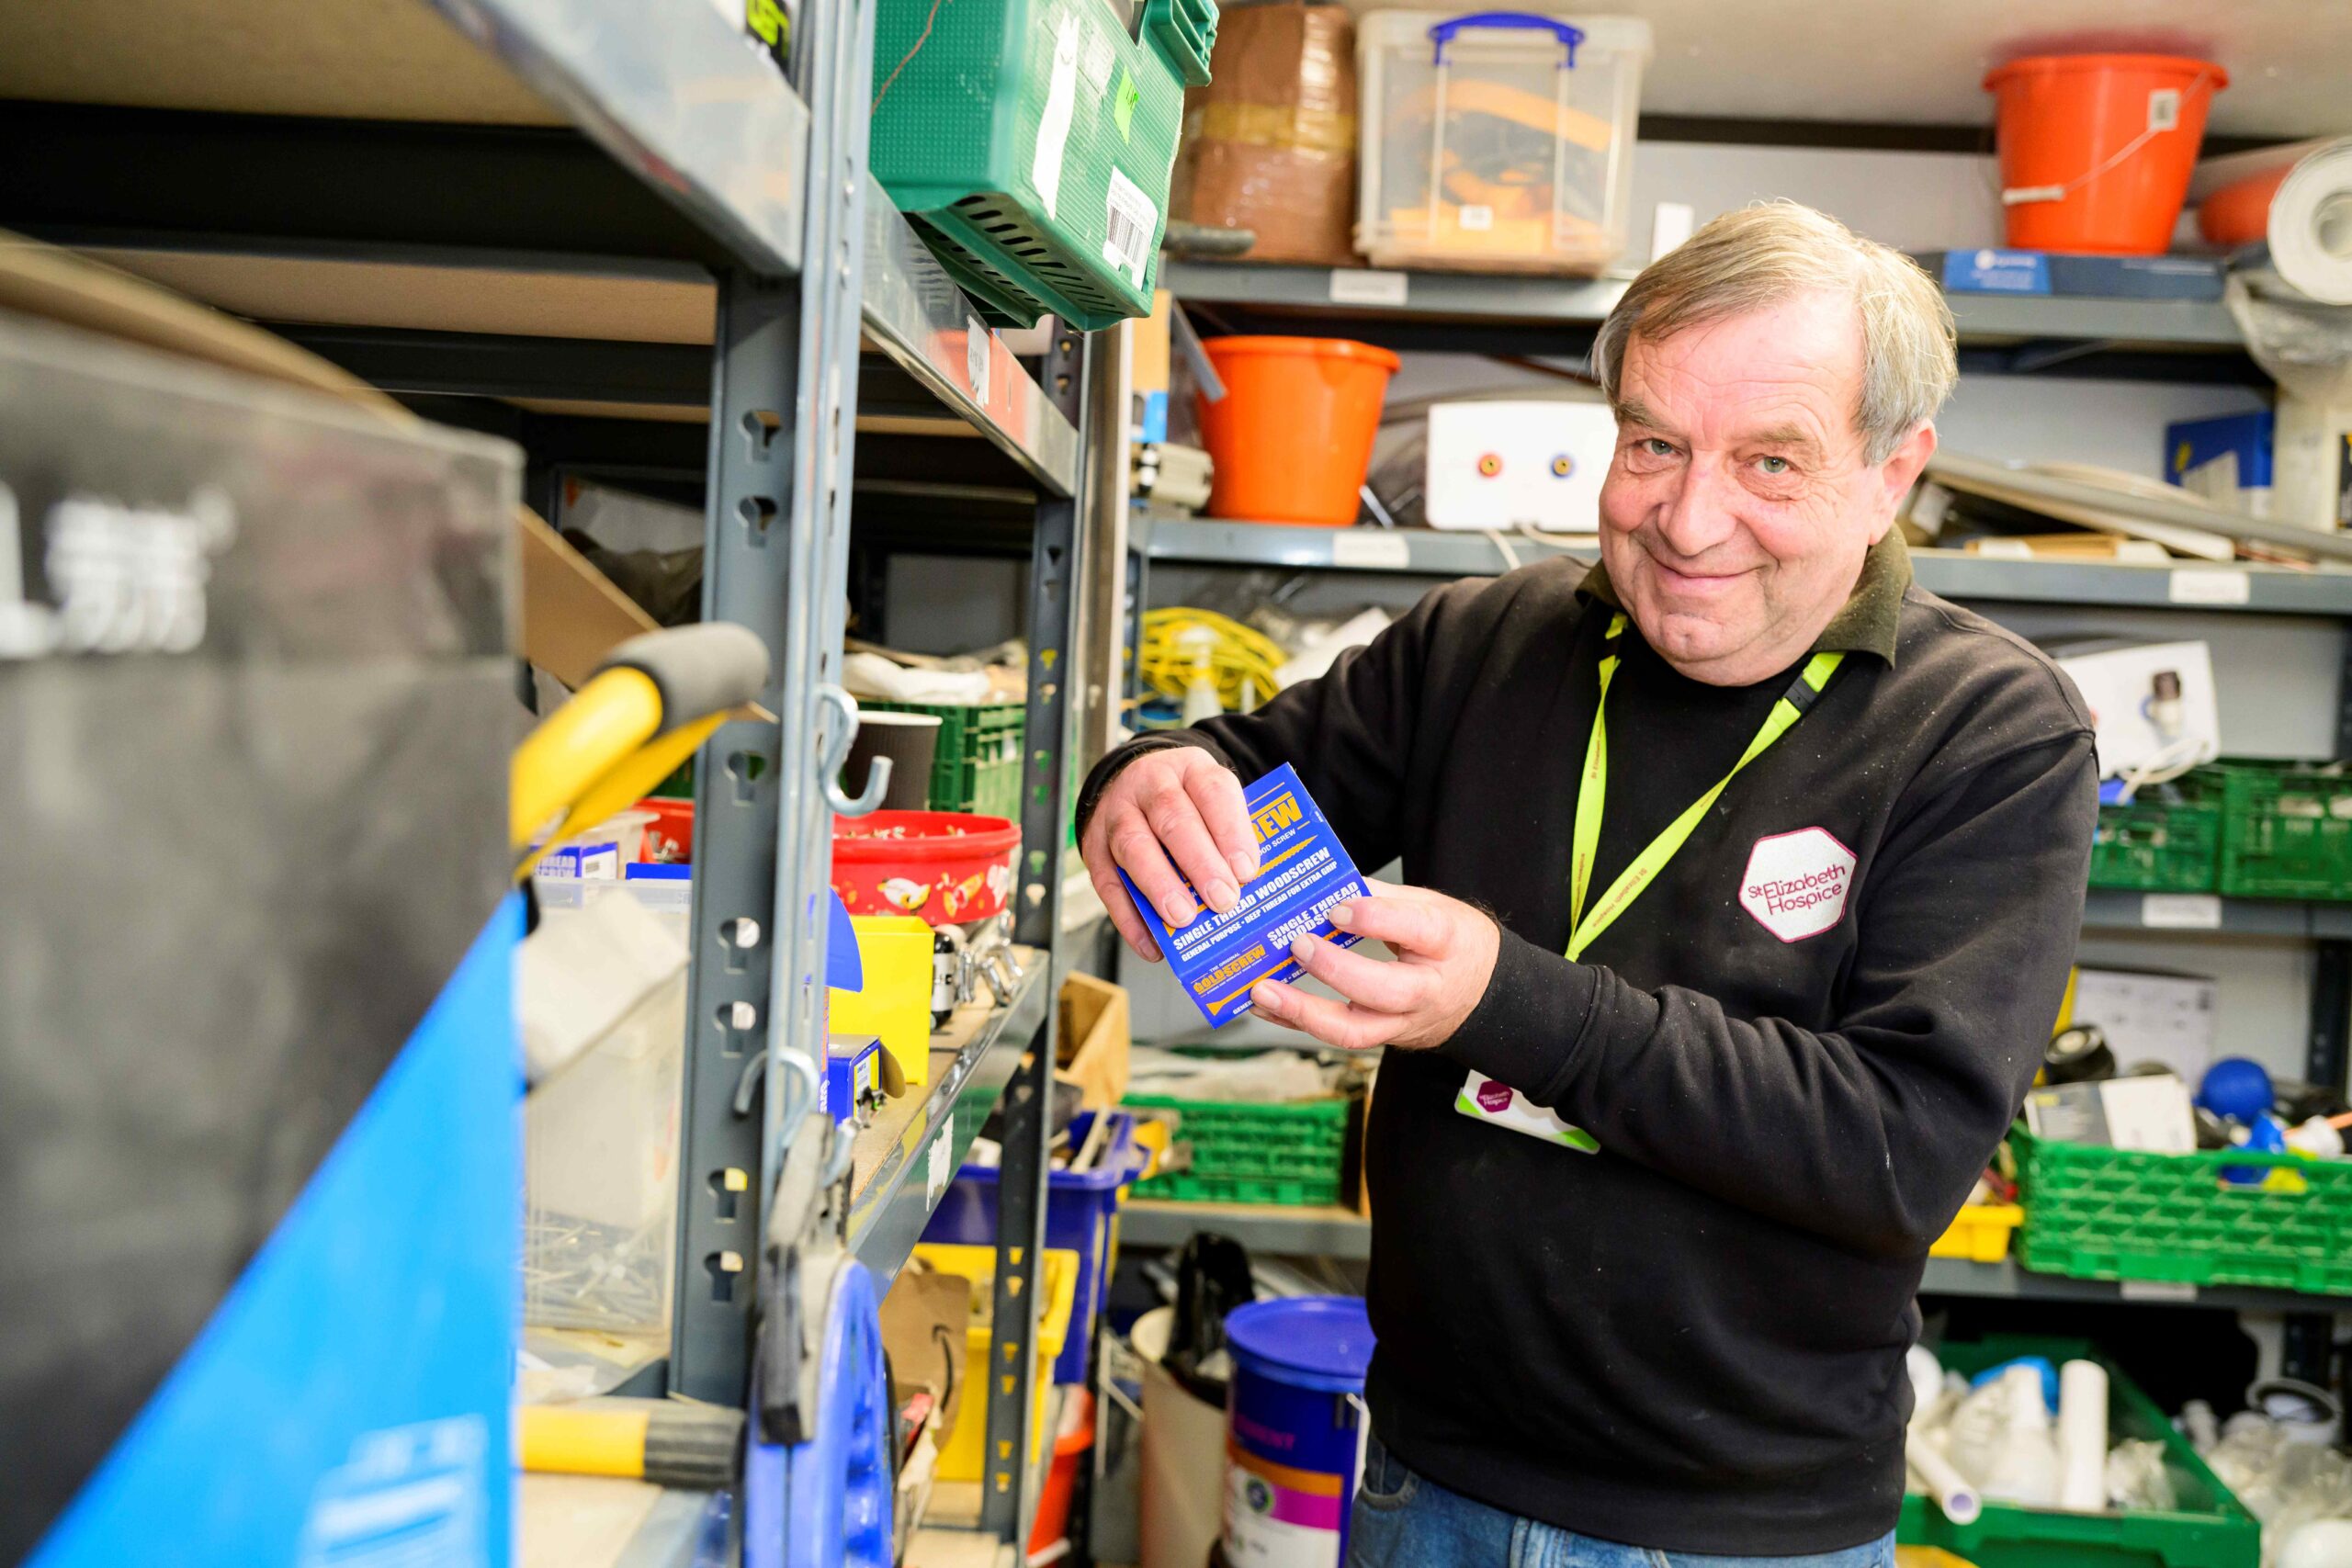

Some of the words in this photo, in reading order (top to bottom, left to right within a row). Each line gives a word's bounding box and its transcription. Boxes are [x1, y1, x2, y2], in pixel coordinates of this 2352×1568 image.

[1251, 795, 1303, 844] REW
[1272, 828, 1296, 847] SCREW
[1173, 921, 1215, 951] SINGLE
[1211, 894, 1257, 927] THREAD
[1254, 847, 1330, 900] WOODSCREW
[1748, 886, 1763, 899] St
[1763, 864, 1846, 900] Elizabeth
[1767, 883, 1842, 916] Hospice
[1181, 939, 1215, 963] GENERAL
[1210, 923, 1242, 943] PURPOSE
[1244, 909, 1262, 924] DEEP
[1261, 895, 1288, 913] THREAD
[1286, 887, 1300, 898] FOR
[1298, 871, 1324, 890] EXTRA
[1320, 861, 1338, 875] GRIP
[1267, 909, 1311, 942] SINGLE
[1309, 881, 1360, 910] THREAD
[1193, 944, 1266, 993] GOLDSCREW
[1232, 1000, 1253, 1014] GENER
